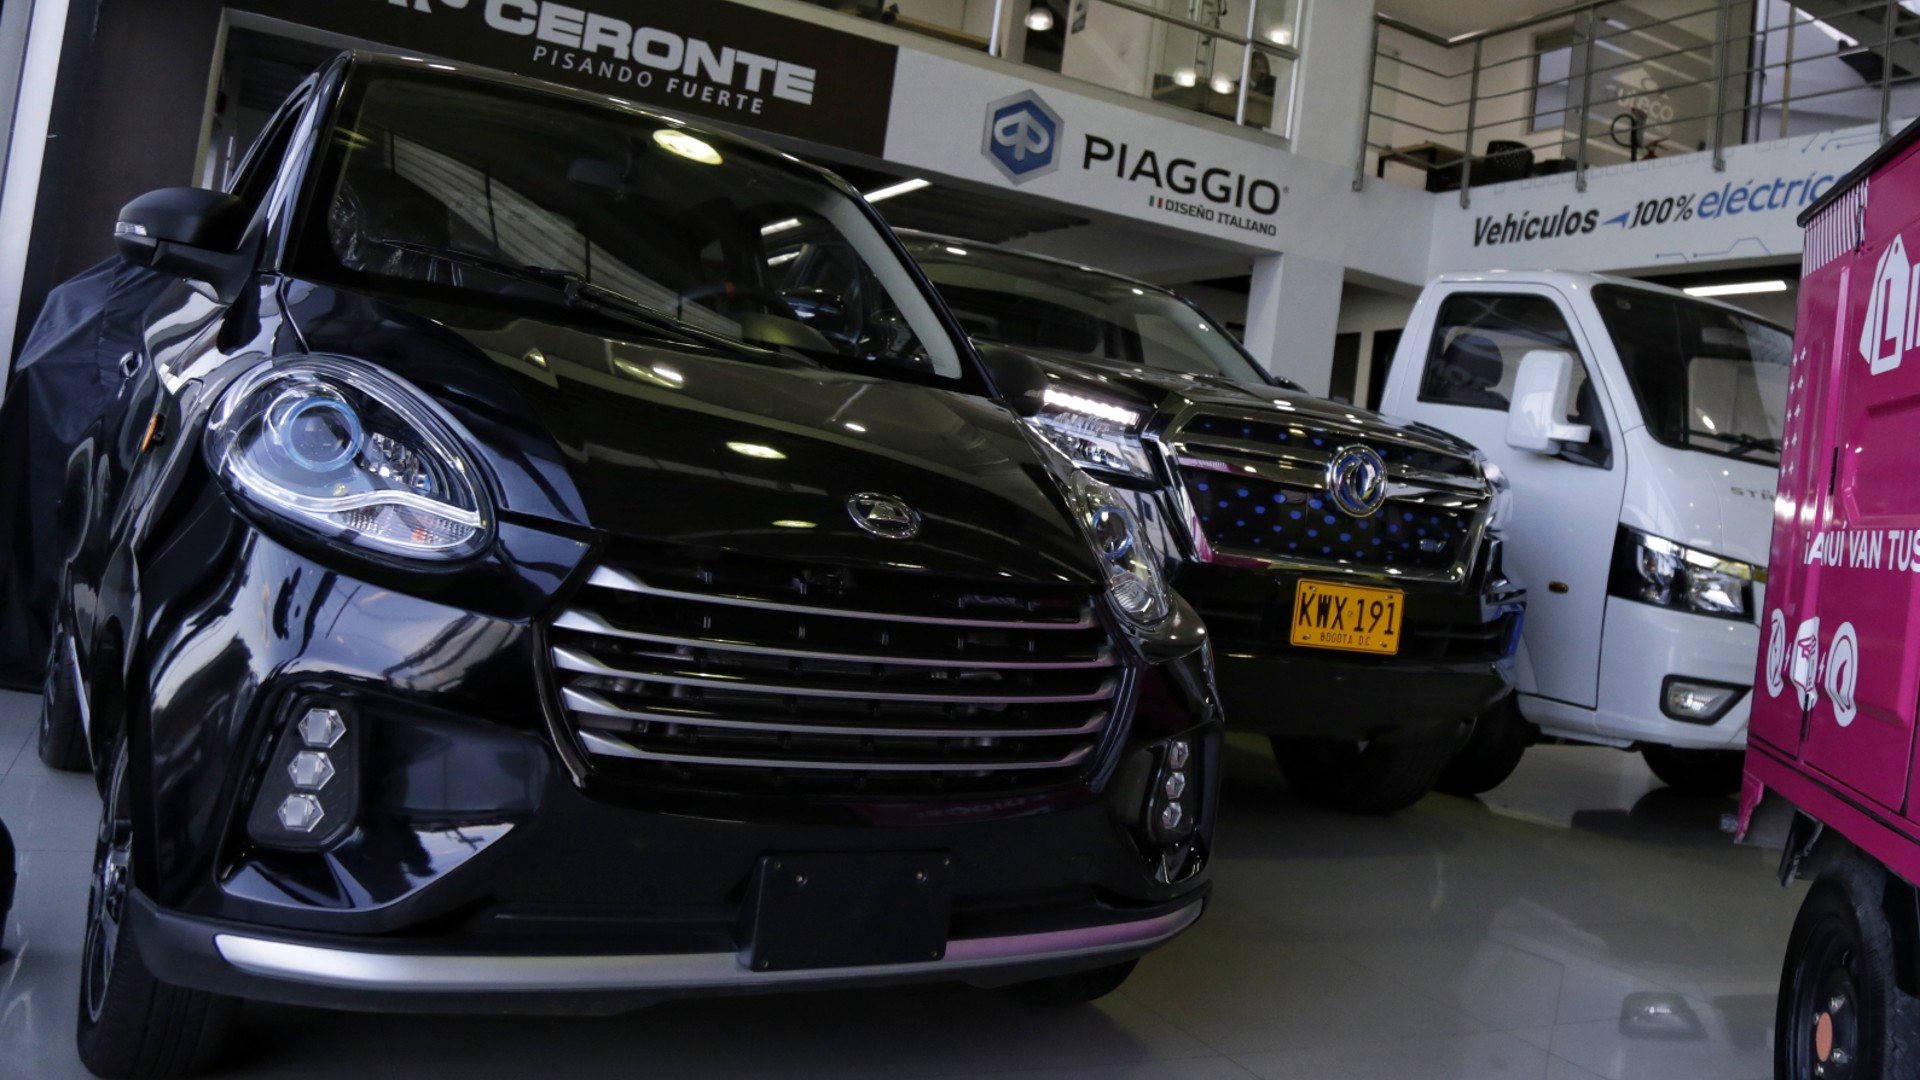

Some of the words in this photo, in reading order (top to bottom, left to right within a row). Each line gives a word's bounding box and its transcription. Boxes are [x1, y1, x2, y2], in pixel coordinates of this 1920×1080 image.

[484, 0, 816, 105] CERONTE
[533, 45, 653, 88] PISANDO
[666, 77, 764, 115] FUERTE
[1165, 199, 1214, 221] DISEÑO
[1217, 212, 1277, 237] ITALIANO
[1473, 204, 1599, 248] Vehículos
[1628, 193, 1695, 230] 100%
[1697, 171, 1850, 219] eléctric
[1851, 530, 1882, 569] VAN
[1299, 592, 1347, 630] KWX
[1353, 598, 1395, 635] 191
